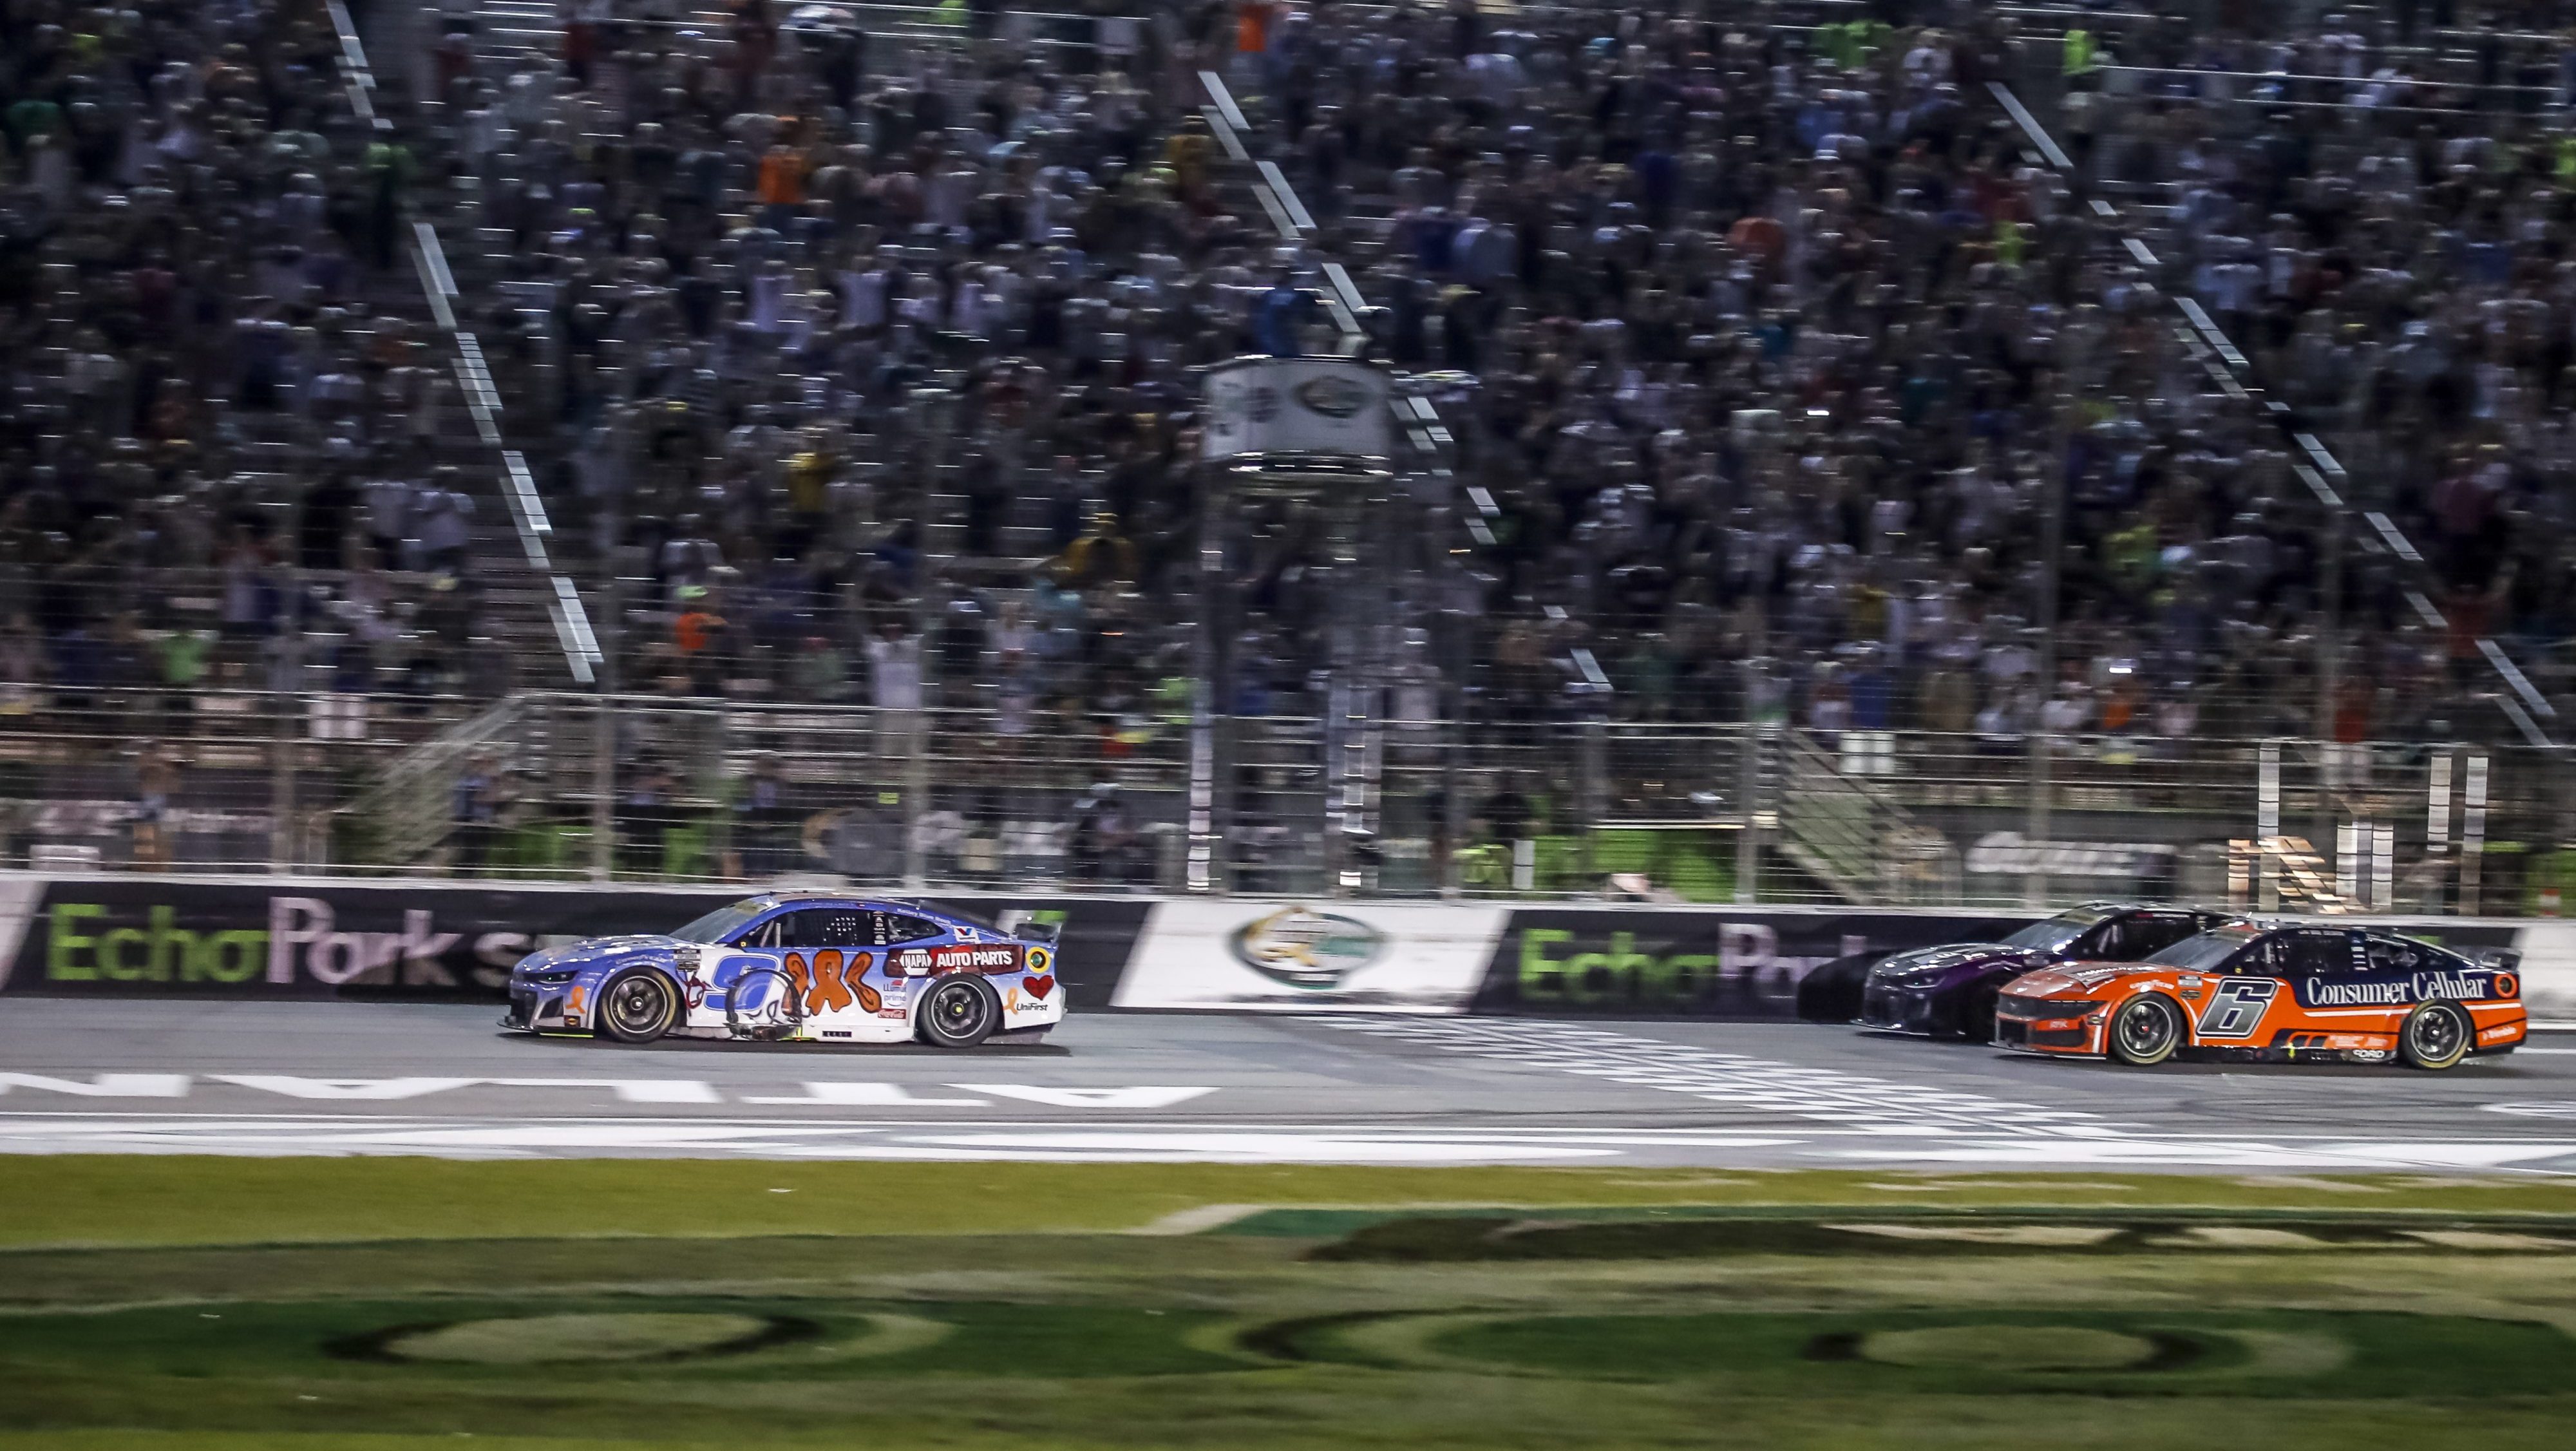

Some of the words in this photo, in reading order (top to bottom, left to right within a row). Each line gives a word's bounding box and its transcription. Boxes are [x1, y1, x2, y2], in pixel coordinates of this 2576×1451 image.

[46, 896, 462, 983] EchoPark
[904, 954, 928, 967] NAPA
[936, 952, 970, 967] AUTO
[972, 951, 1012, 966] PARTS
[1518, 923, 1866, 1002] EchoPa
[704, 953, 781, 1011] 9
[1016, 1003, 1048, 1011] UniFirst
[2195, 976, 2279, 1039] 6
[2306, 977, 2410, 1005] Consumer
[2412, 971, 2486, 1000] Cellular
